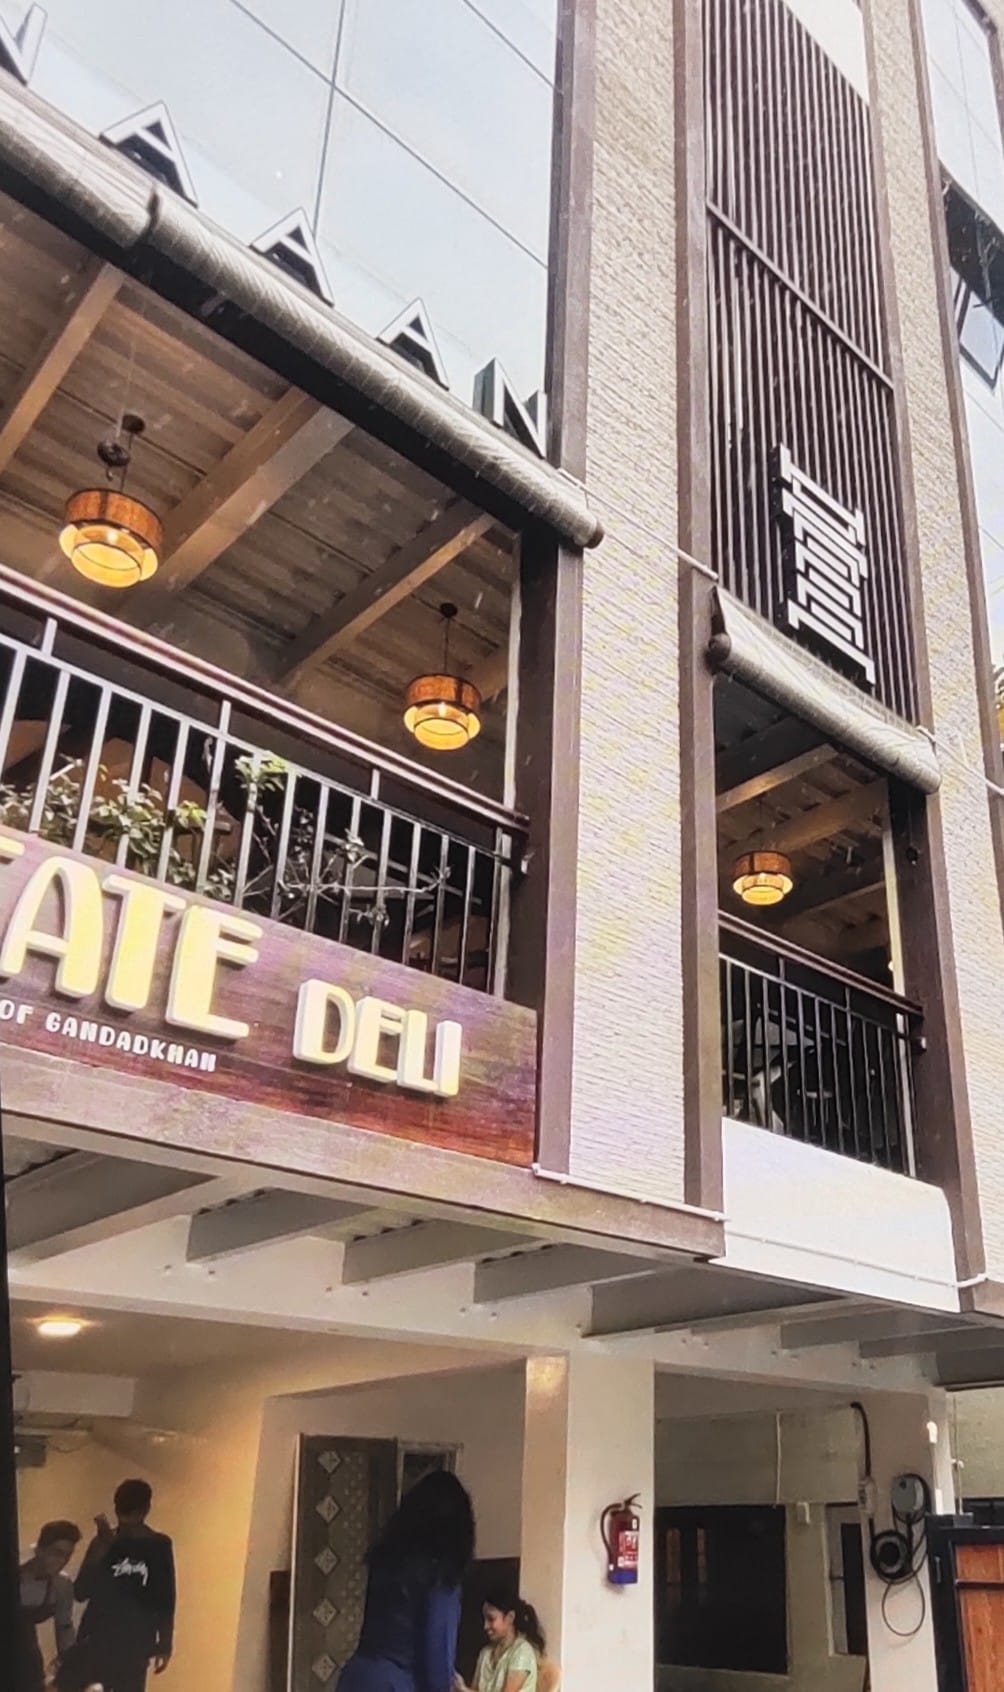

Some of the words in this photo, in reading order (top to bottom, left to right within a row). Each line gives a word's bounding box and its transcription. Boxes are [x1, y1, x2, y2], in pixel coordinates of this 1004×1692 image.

[0, 834, 263, 1038] ATE
[293, 978, 462, 1097] DELI
[0, 1000, 34, 1025] OF
[45, 1011, 217, 1072] GANDADKHAN
